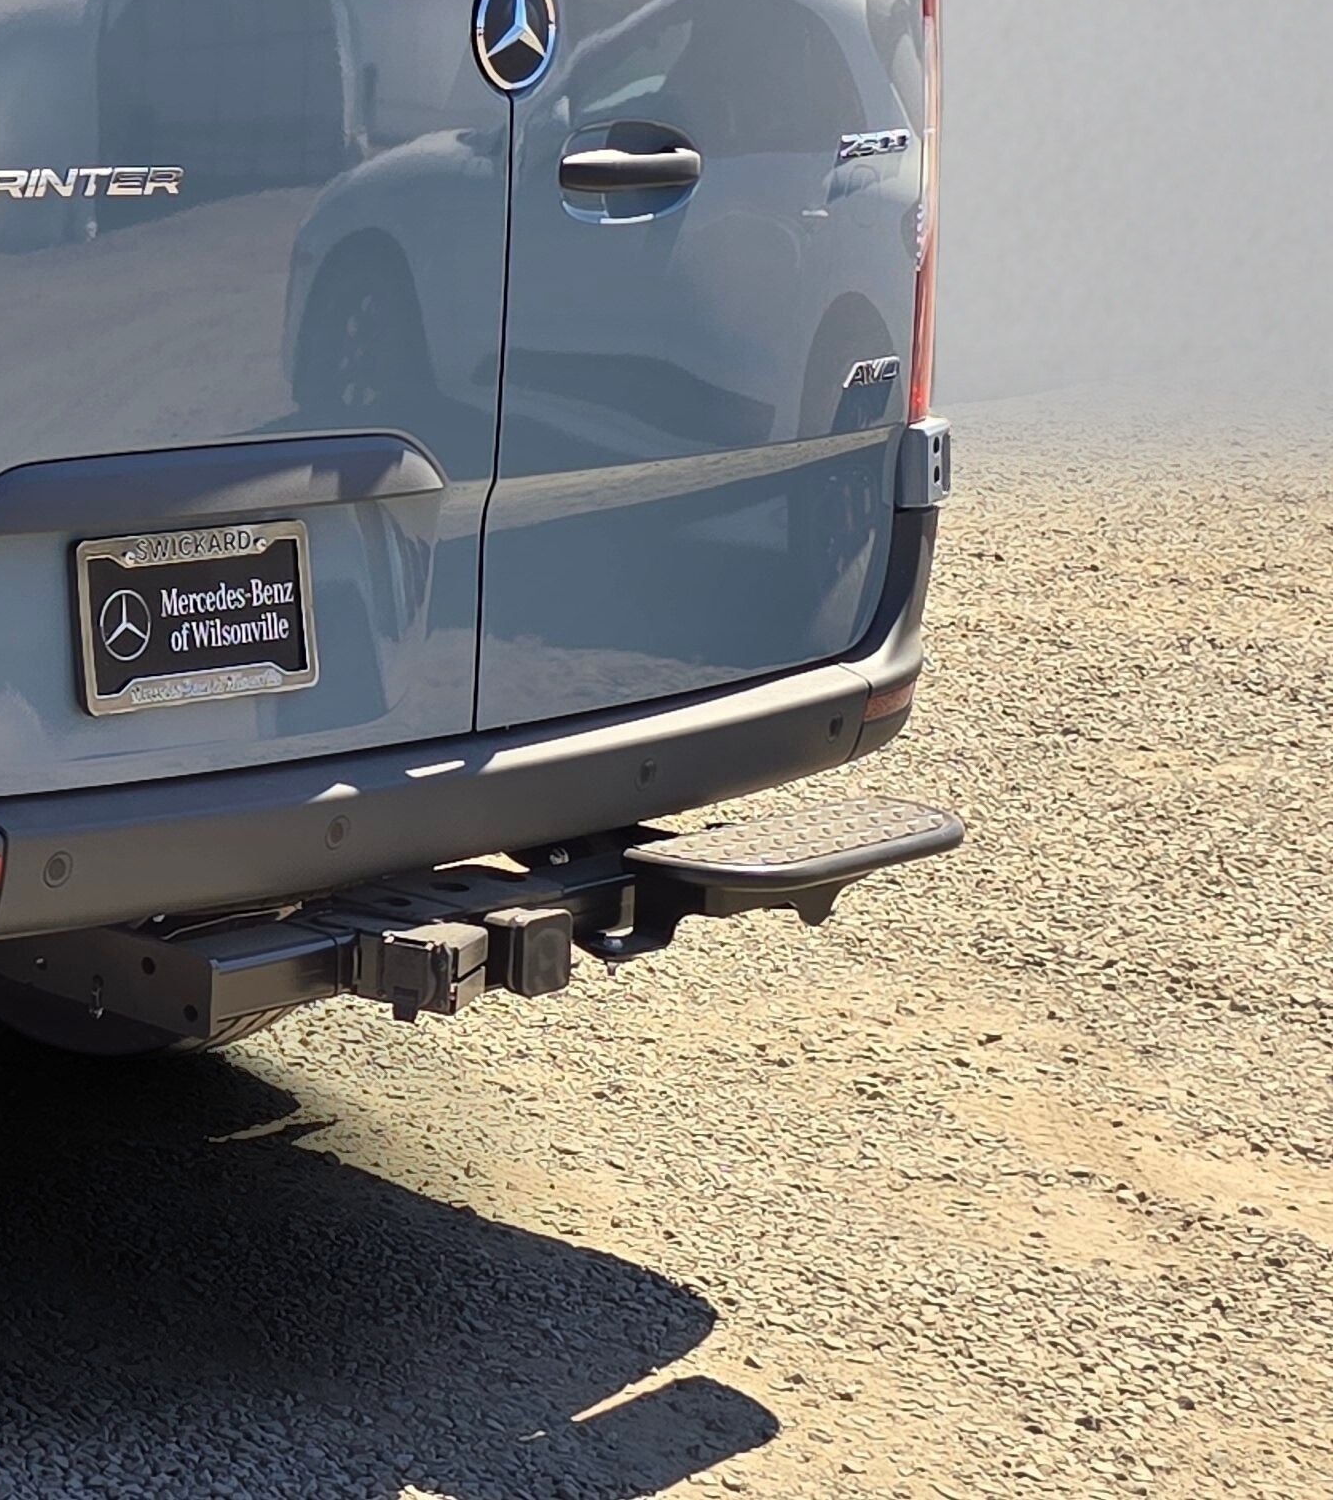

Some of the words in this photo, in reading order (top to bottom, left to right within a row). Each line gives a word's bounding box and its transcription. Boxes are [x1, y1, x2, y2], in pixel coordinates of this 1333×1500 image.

[842, 355, 900, 389] AWD
[135, 530, 251, 562] SWICKARD
[159, 577, 295, 618] Mercedes-Benz
[170, 618, 191, 652] of
[191, 612, 290, 649] Wilsonville
